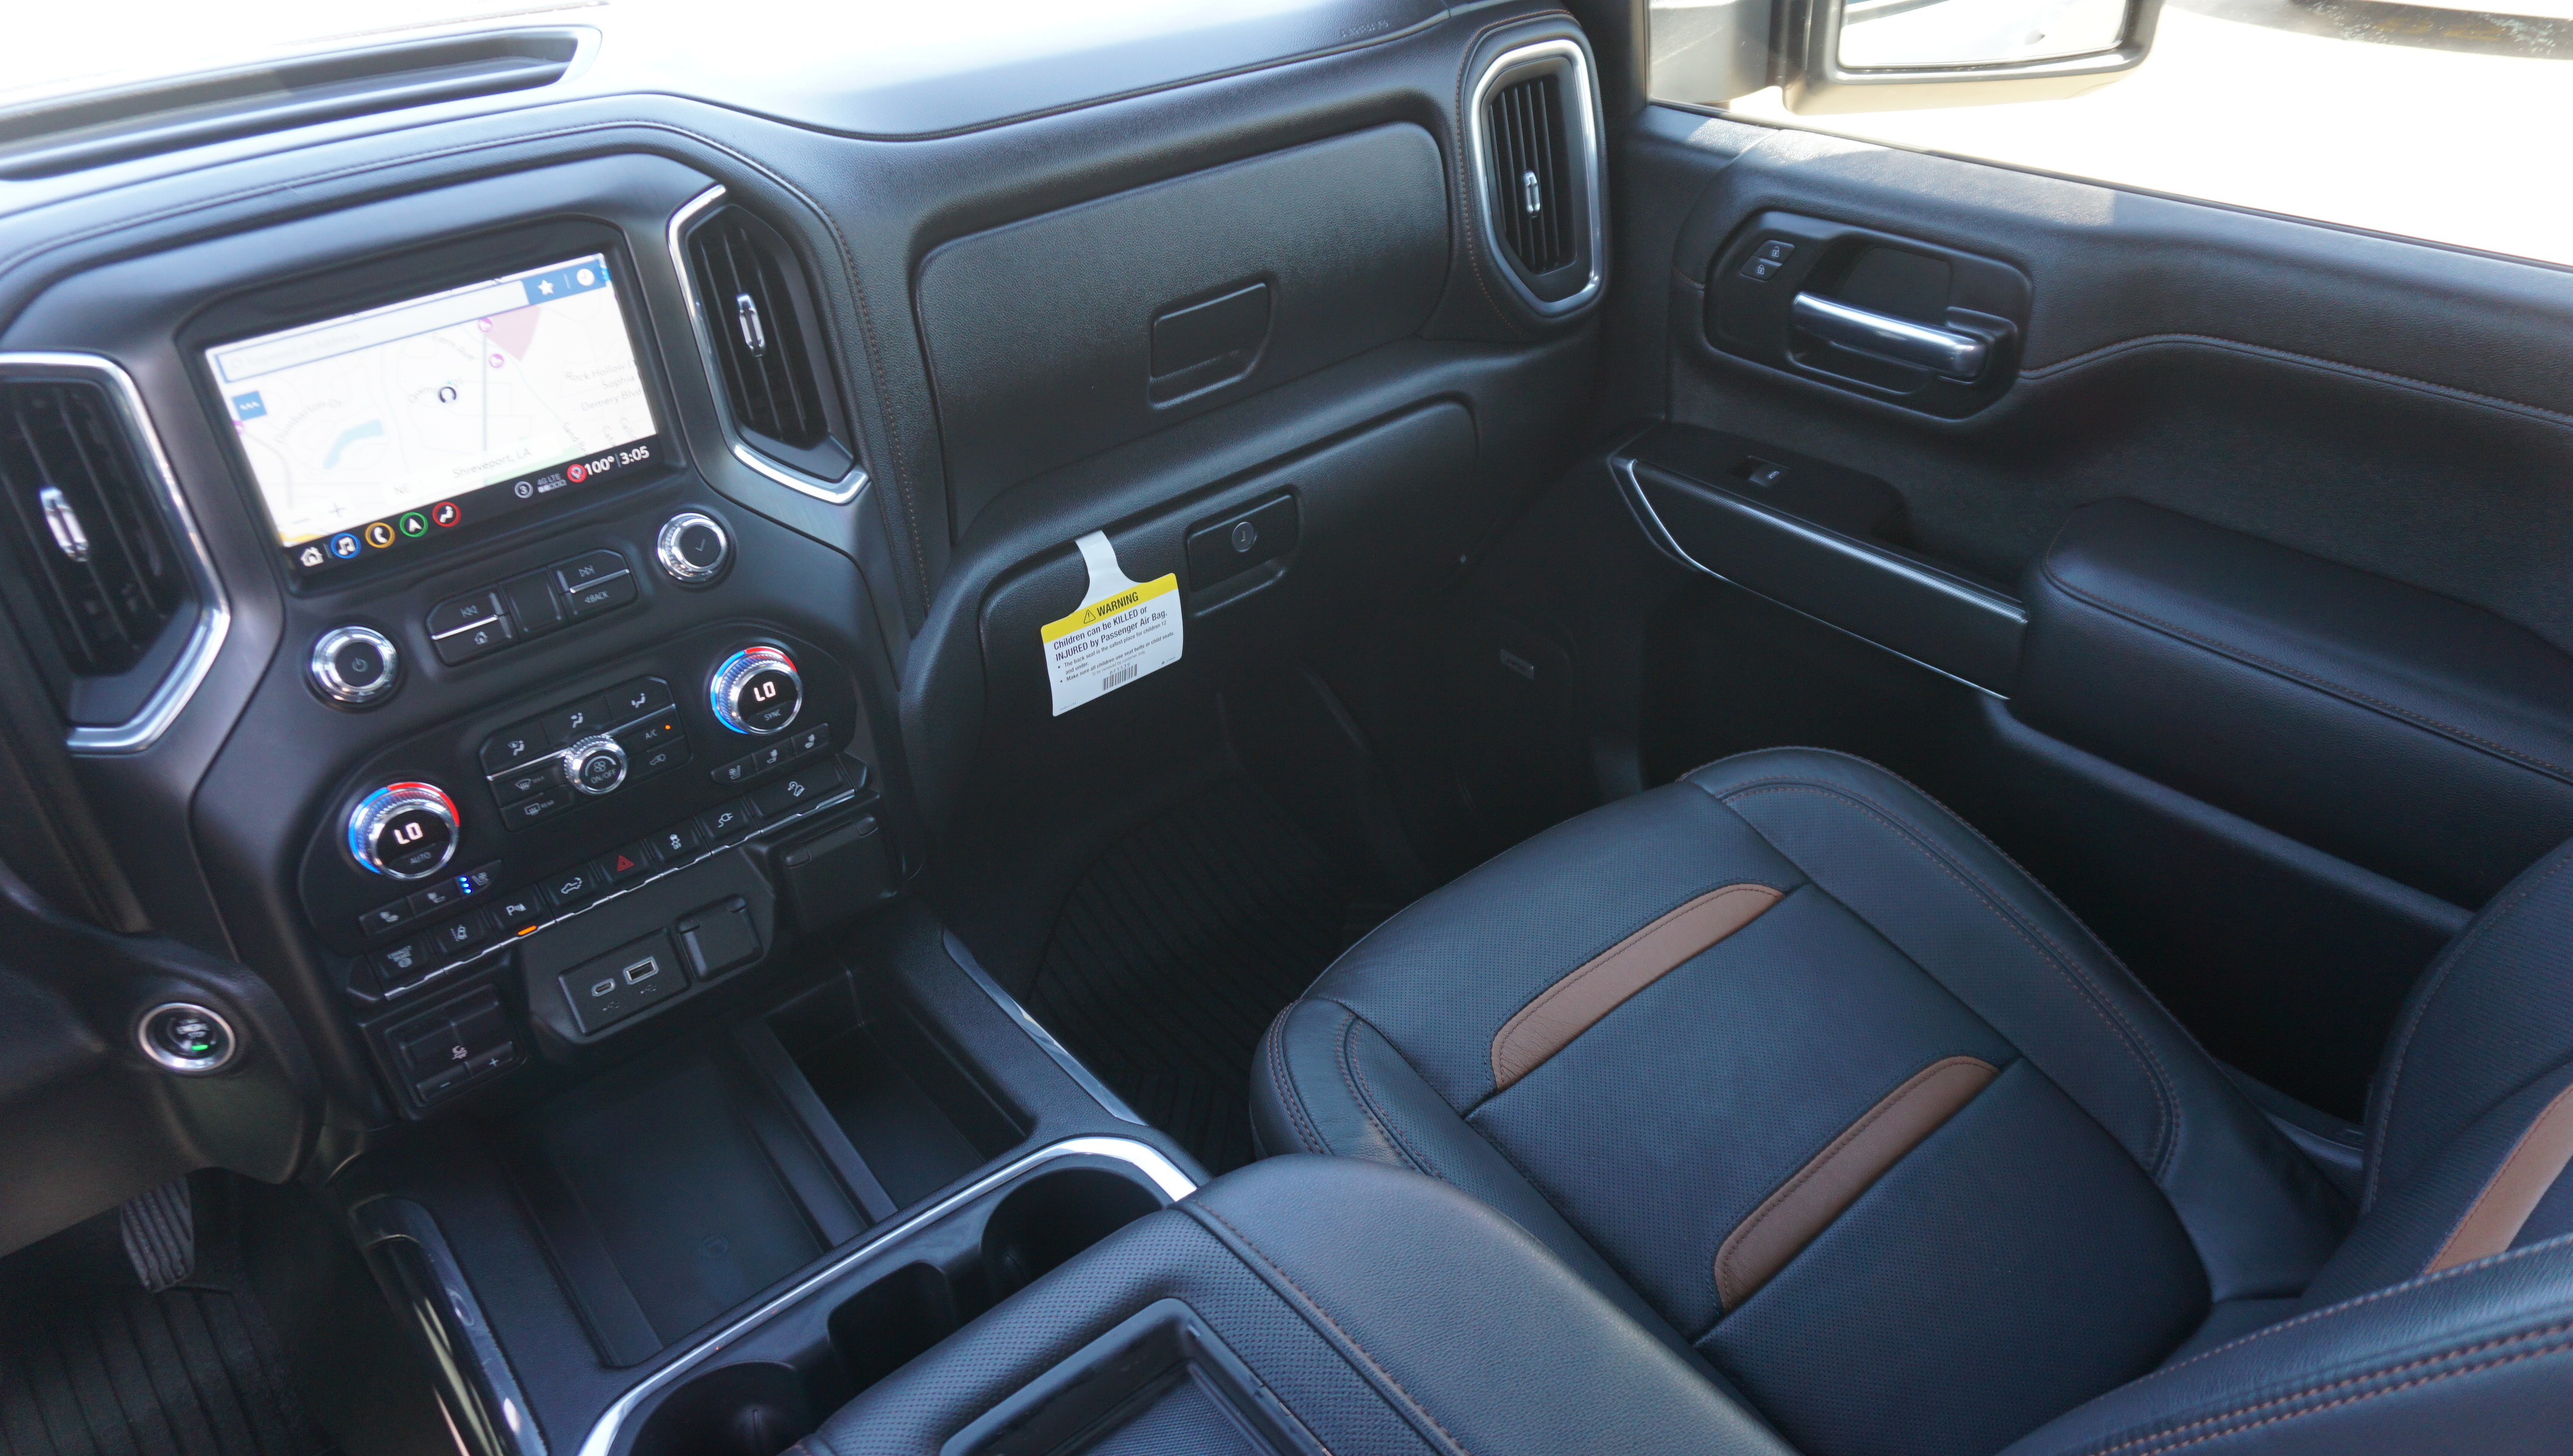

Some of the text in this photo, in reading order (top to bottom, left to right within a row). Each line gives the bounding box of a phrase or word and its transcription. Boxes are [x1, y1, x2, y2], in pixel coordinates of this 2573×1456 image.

[565, 371, 590, 382] Rock
[592, 363, 626, 378] Hollow
[601, 375, 635, 389] Sophia
[580, 386, 642, 411] Demery Blvd
[562, 422, 580, 442] Sand
[452, 447, 532, 478] Shreveport, LA
[620, 445, 650, 465] 3:05
[536, 473, 561, 485] 4G LTE
[393, 483, 409, 495] NE
[1096, 592, 1139, 617] WARNING
[1053, 606, 1148, 650] Children can be KILLED or
[1055, 610, 1168, 662] INJURED by Passenger Air Bag.
[1073, 655, 1085, 664] back
[1086, 651, 1095, 659] seat
[1109, 639, 1123, 649] safest
[1123, 634, 1135, 644] place
[1143, 624, 1161, 635] children
[1066, 673, 1079, 682] Make
[1097, 657, 1115, 669] children
[1151, 636, 1161, 645] child
[1162, 632, 1175, 640] seats.
[1075, 662, 1089, 671] under.
[763, 709, 782, 721] SYNC
[644, 729, 658, 740] A/C
[590, 768, 618, 784] ON/OFF
[409, 851, 432, 865] AUTO
